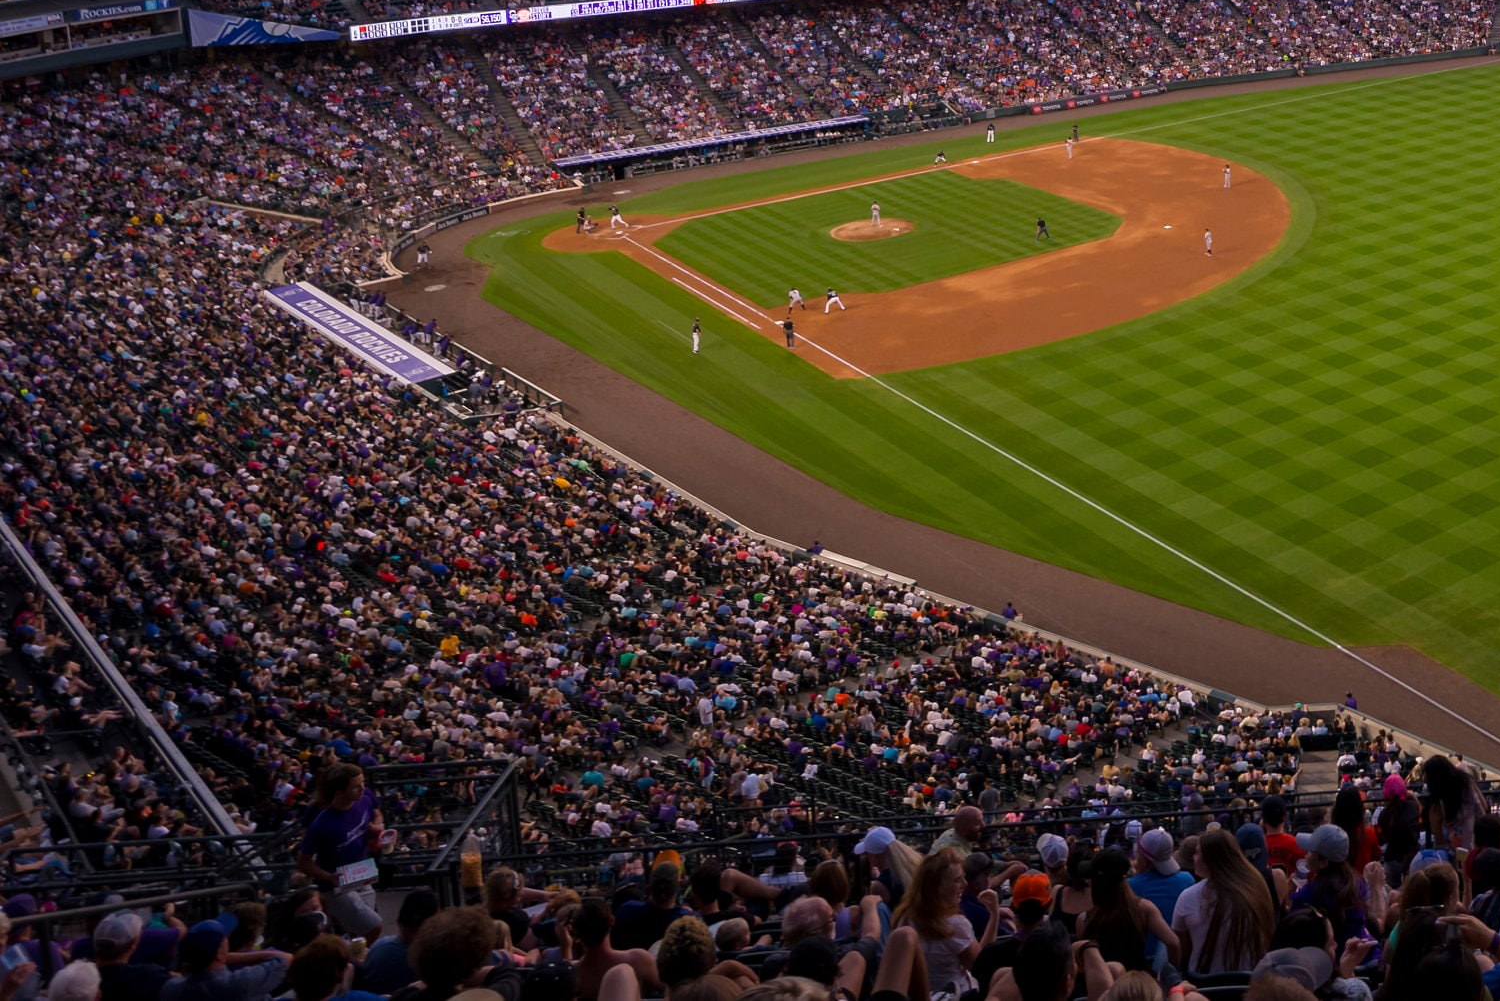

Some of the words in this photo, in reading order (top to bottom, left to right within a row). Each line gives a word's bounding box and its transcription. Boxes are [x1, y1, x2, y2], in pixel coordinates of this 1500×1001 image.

[80, 5, 142, 20] ROCKIES.com
[296, 299, 356, 334] COLORADO
[348, 330, 409, 364] ROCKIES
